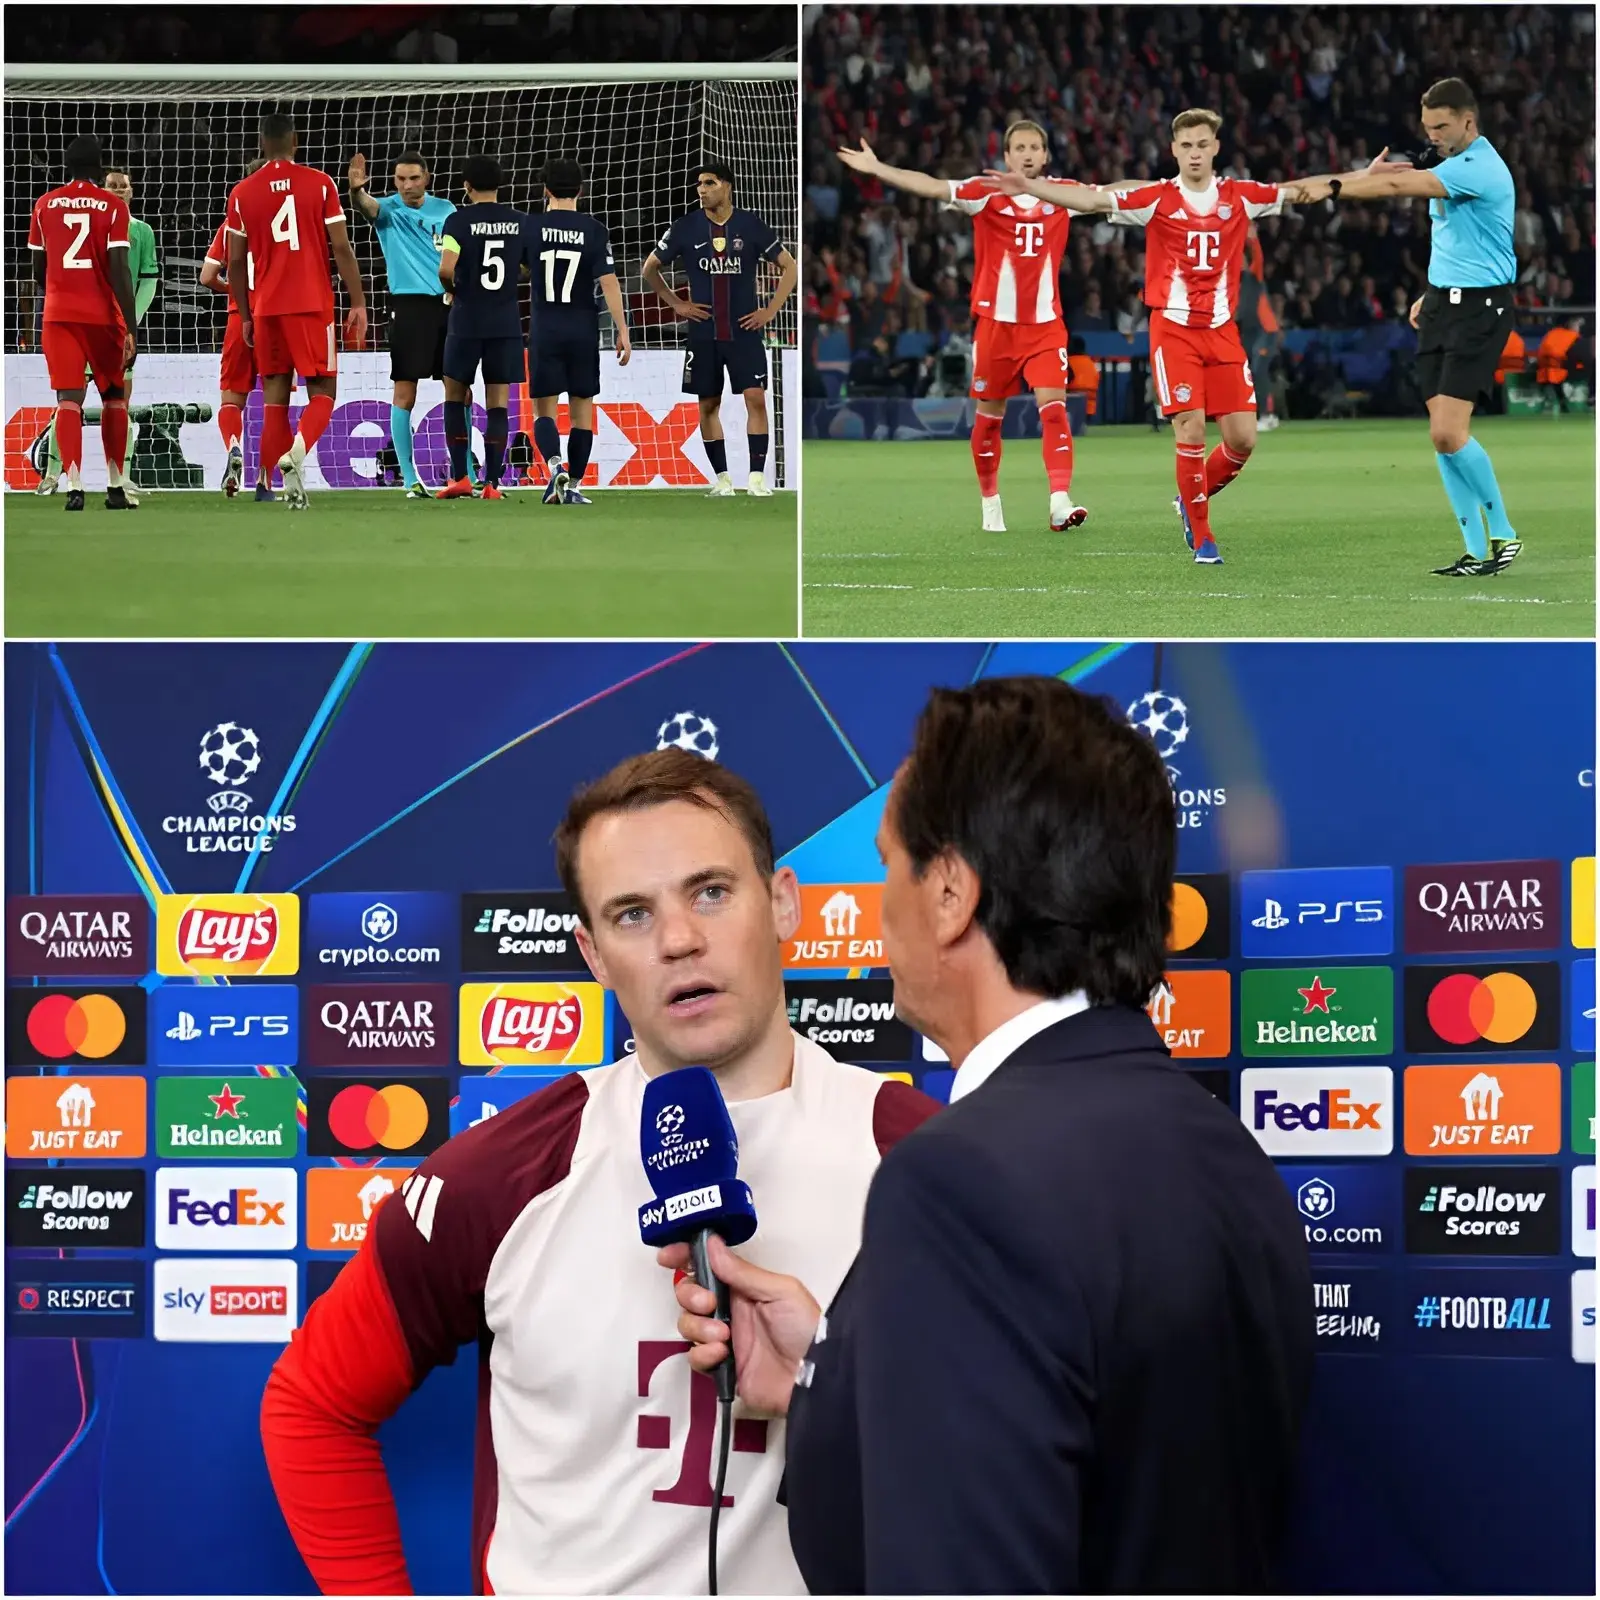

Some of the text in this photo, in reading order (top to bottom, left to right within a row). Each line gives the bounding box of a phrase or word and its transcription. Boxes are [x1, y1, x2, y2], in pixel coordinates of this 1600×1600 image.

[270, 194, 300, 251] 4
[63, 213, 93, 269] 2
[1015, 223, 1044, 257] T
[1186, 231, 1220, 270] T
[480, 240, 505, 291] 5
[539, 249, 582, 303] 17
[162, 815, 297, 834] CHAMPIONS
[186, 836, 273, 853] LEAGUE
[1418, 878, 1542, 918] QATAR
[1299, 900, 1383, 923] PS5
[1448, 911, 1544, 932] AIRWAYS
[20, 911, 132, 945] QATAR
[184, 909, 273, 963] Lay's
[46, 941, 133, 958] AIRWAYS
[318, 946, 441, 967] crypto.com
[790, 940, 844, 961] JUST
[210, 1015, 289, 1037] PS5
[320, 1000, 434, 1034] QATAR
[487, 999, 576, 1053] Lay's
[347, 1030, 436, 1049] AIRWAYS
[1255, 1020, 1377, 1044] Heineken
[1254, 1089, 1382, 1131] FedEx
[29, 1130, 79, 1150] JUST
[1429, 1125, 1534, 1147] JUST EAT
[36, 1185, 133, 1209] Follow
[168, 1188, 285, 1226] FedEx
[1438, 1186, 1546, 1212] Follow
[330, 1223, 367, 1242] JUS
[47, 1290, 134, 1308] RESPECT
[164, 1287, 283, 1315] sky sport
[1313, 1283, 1351, 1308] THAT
[1414, 1296, 1551, 1330] #FOOTBALL
[1317, 1315, 1381, 1341] EELING
